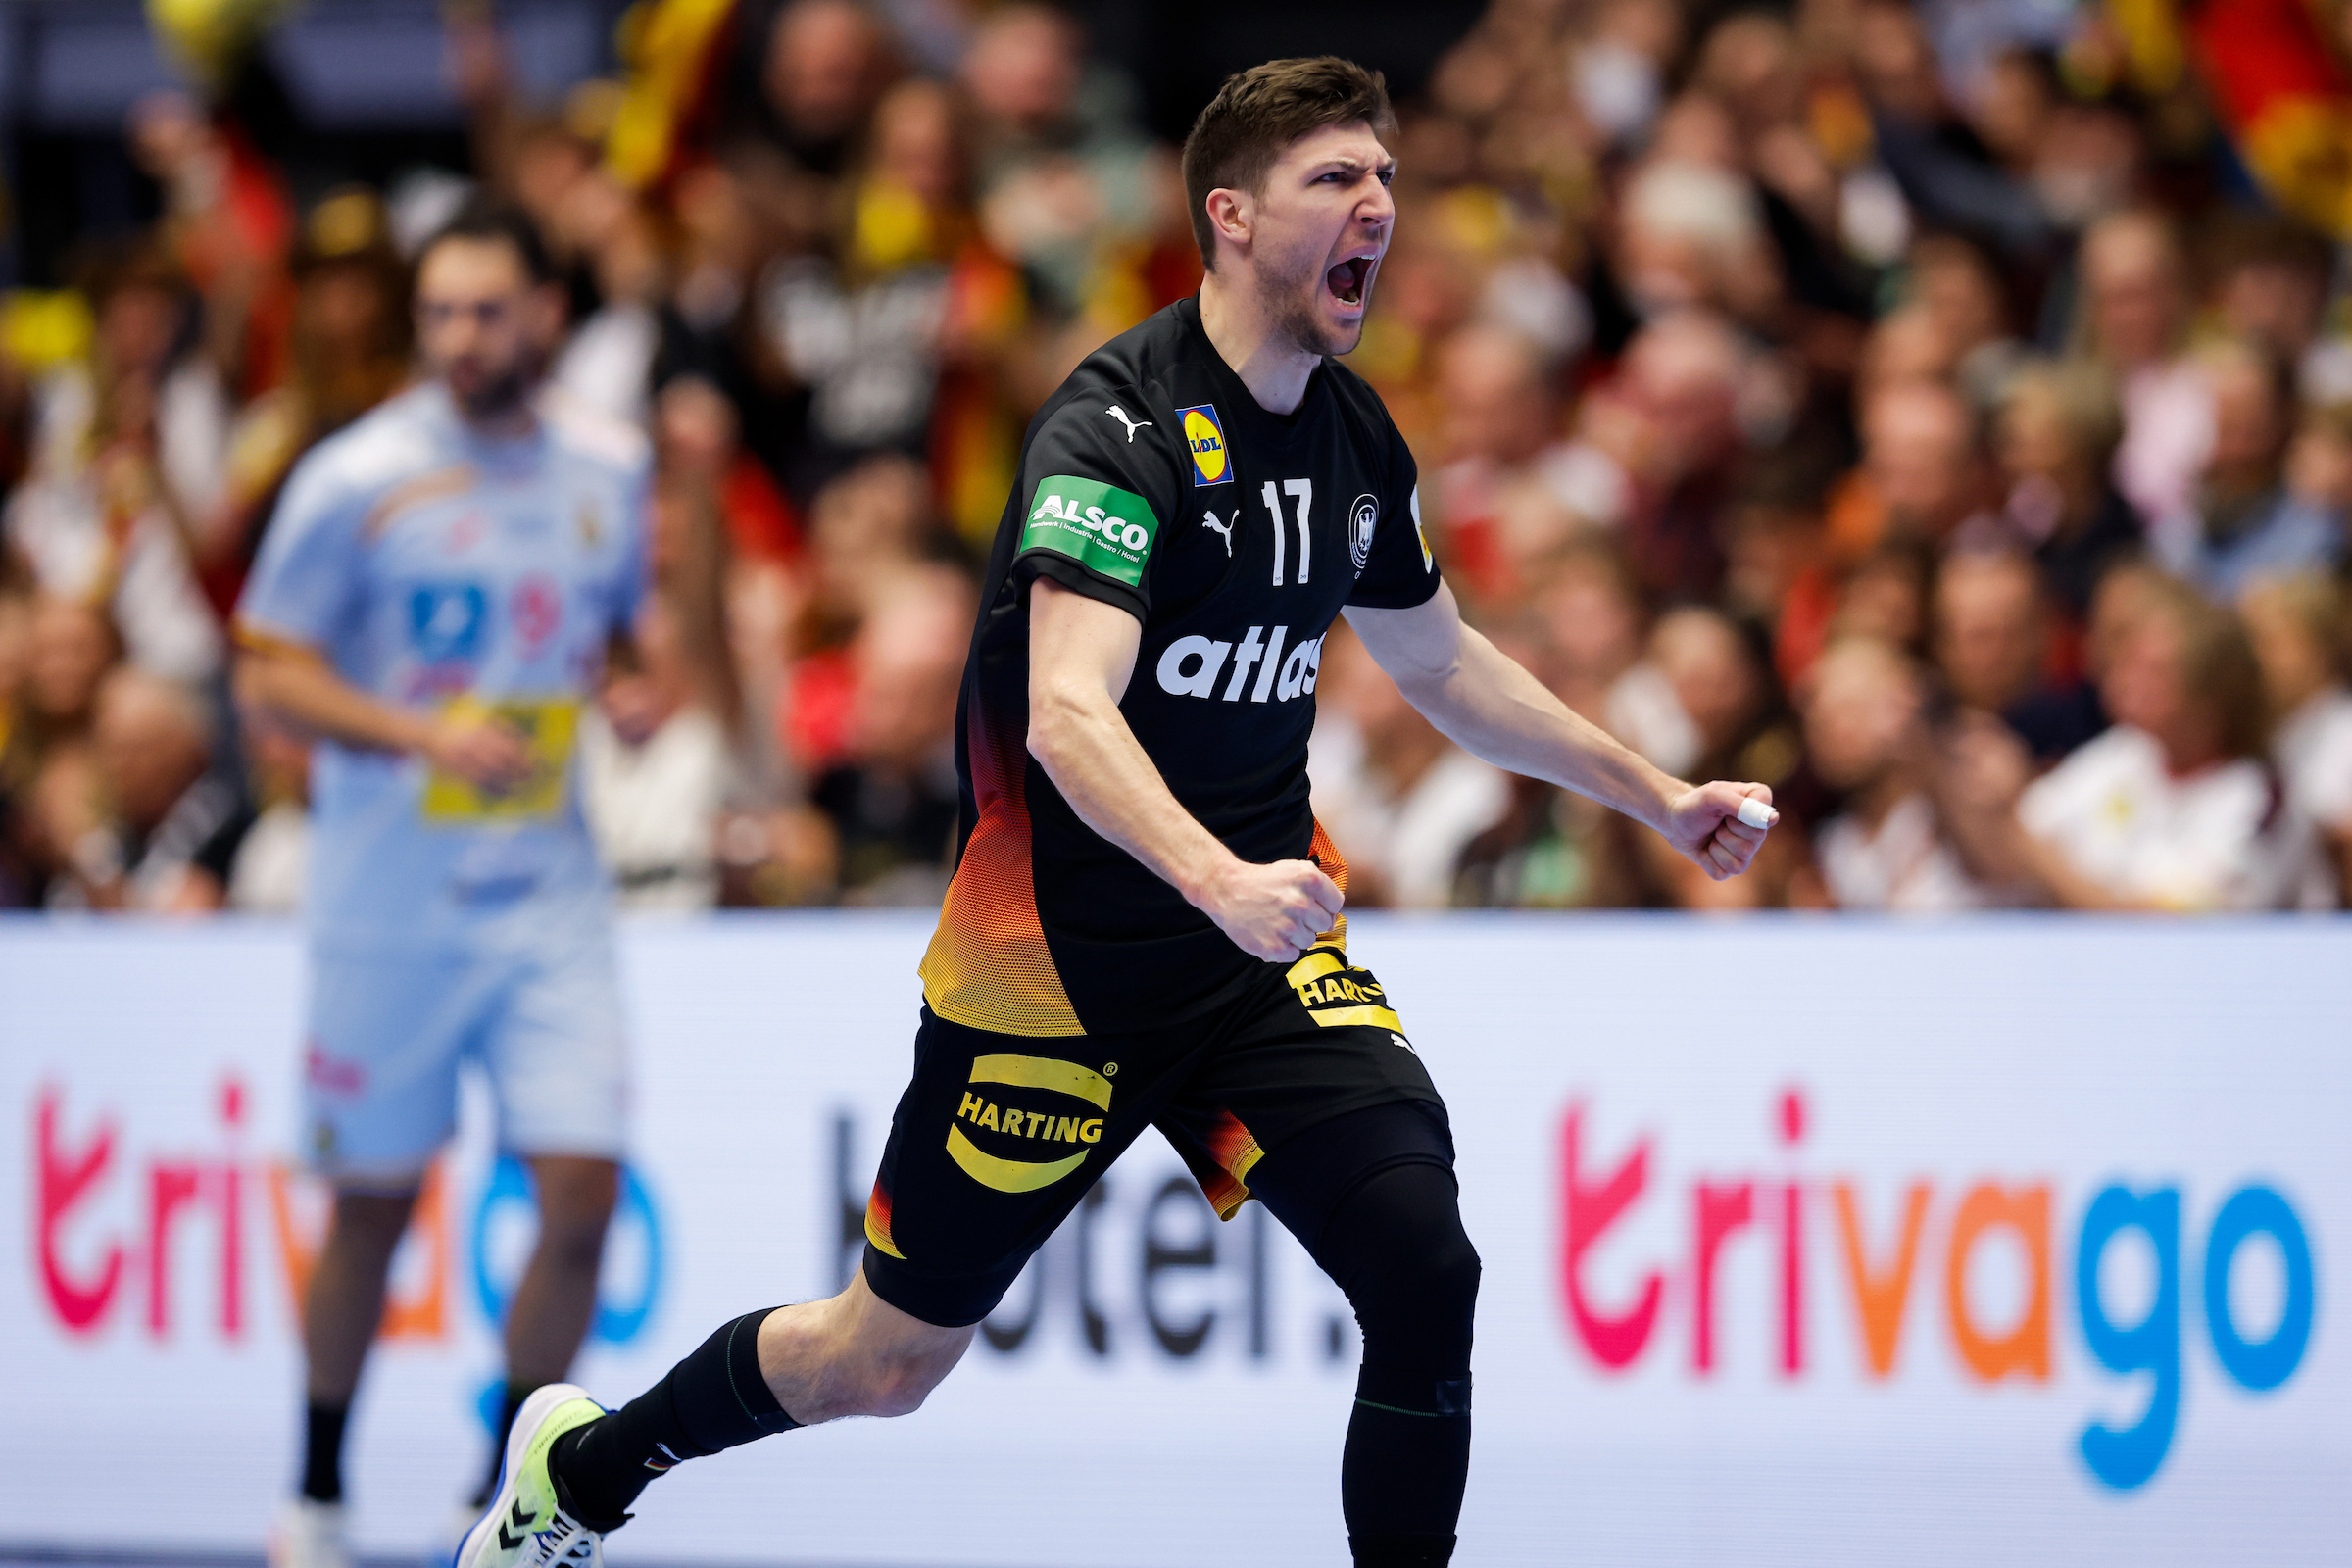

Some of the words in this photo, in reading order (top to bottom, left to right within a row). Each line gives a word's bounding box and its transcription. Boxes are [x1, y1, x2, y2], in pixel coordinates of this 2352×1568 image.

[1029, 520, 1059, 529] Handwerk
[1063, 523, 1094, 540] Industrie
[1096, 537, 1117, 554] Gastro
[1120, 550, 1140, 564] Hotel
[1030, 495, 1149, 551] ALSCO
[1261, 478, 1312, 586] 17
[956, 1091, 1103, 1143] HARTING
[1558, 1084, 2315, 1494] trivago
